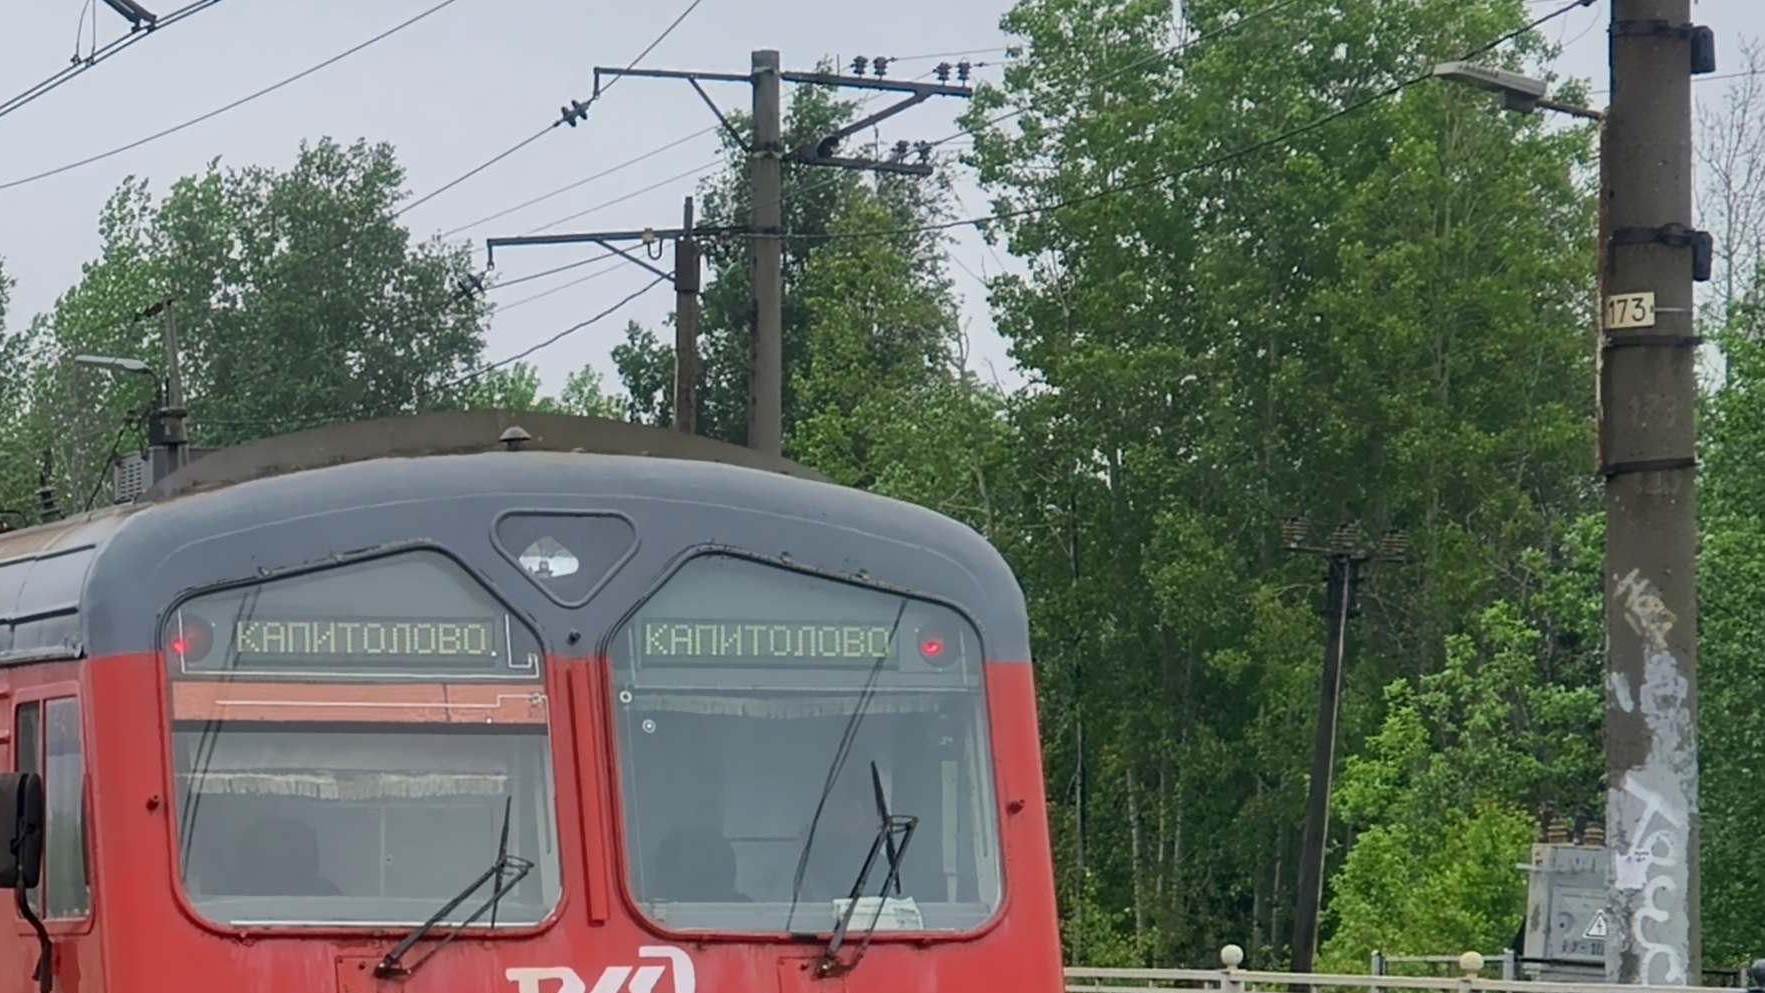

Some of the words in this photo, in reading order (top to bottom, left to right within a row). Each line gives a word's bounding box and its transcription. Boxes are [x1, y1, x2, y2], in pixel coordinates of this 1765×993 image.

[1609, 297, 1646, 324] 173
[237, 621, 486, 654] КАПИТОЛОВО
[646, 623, 890, 657] КАПИТОЛОВО
